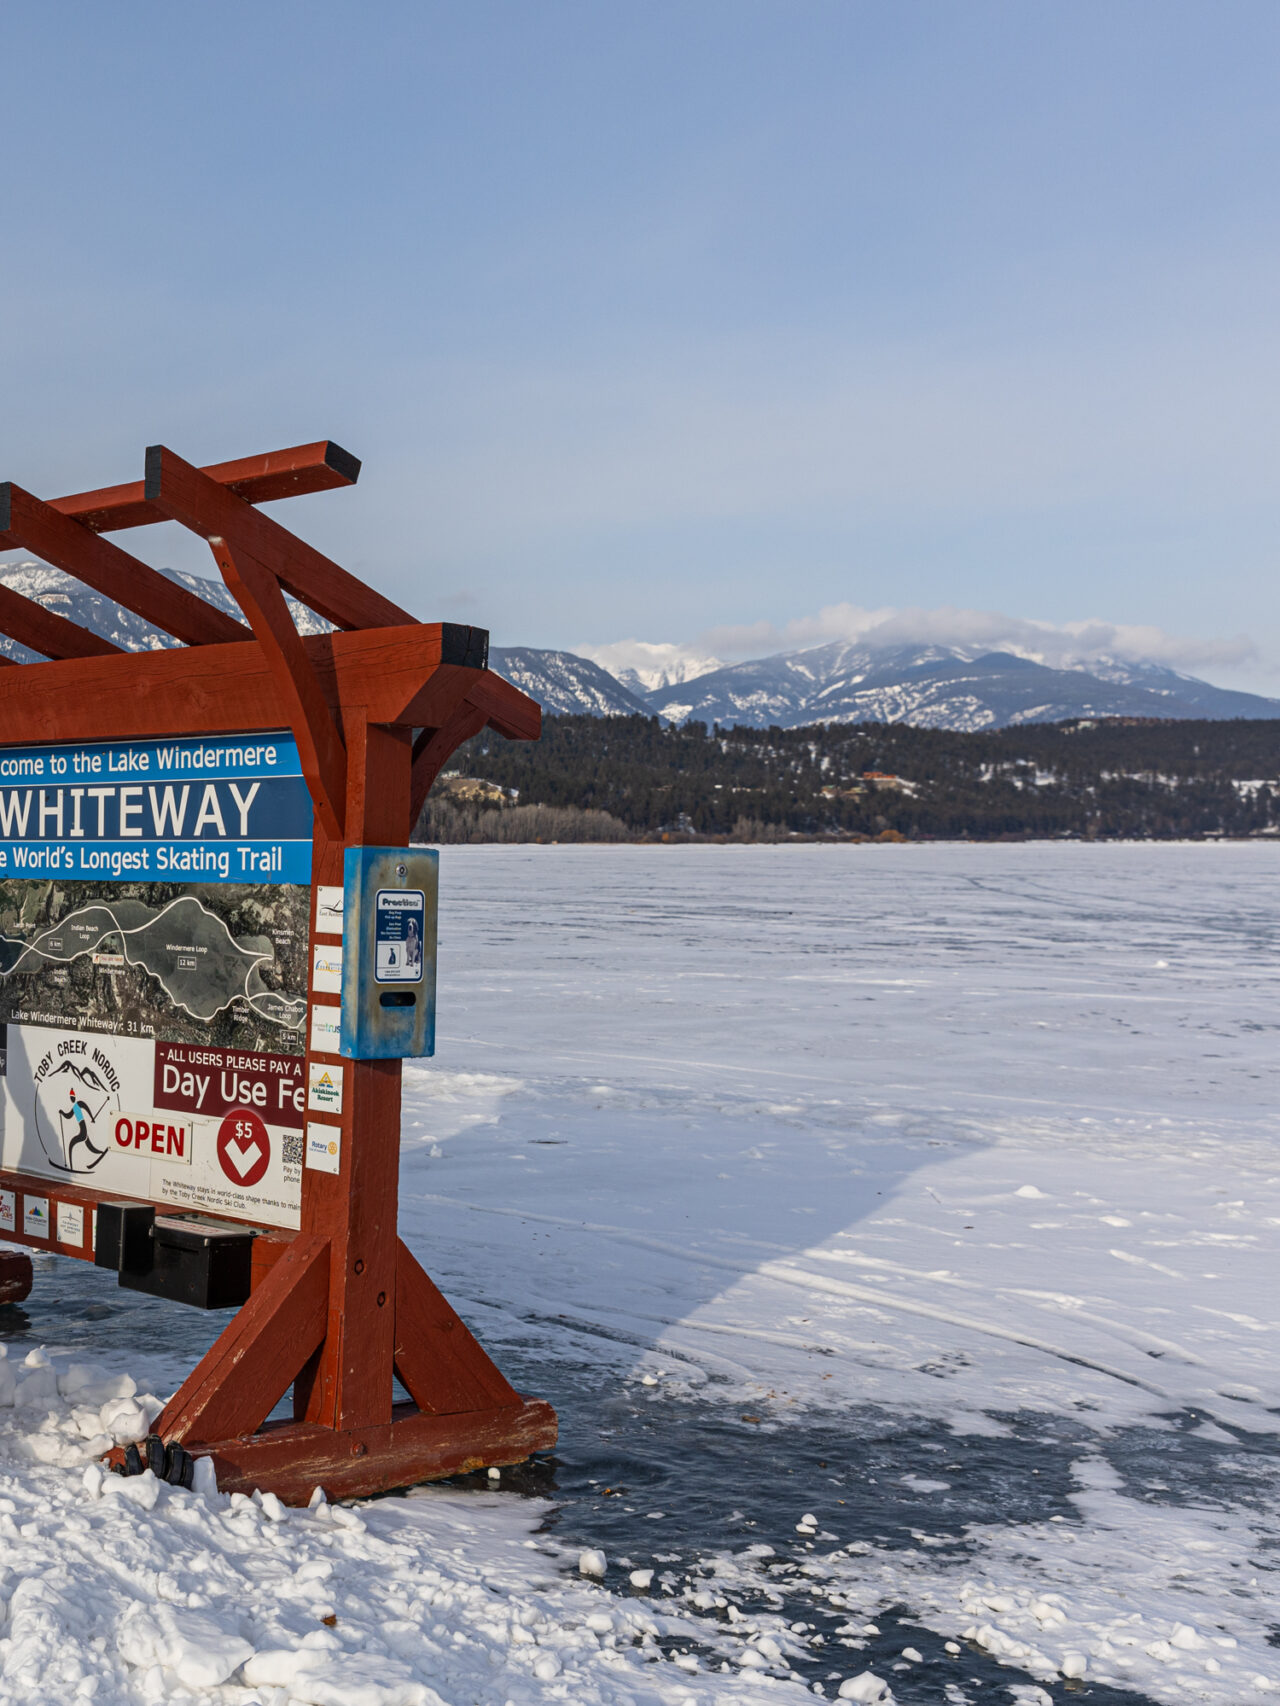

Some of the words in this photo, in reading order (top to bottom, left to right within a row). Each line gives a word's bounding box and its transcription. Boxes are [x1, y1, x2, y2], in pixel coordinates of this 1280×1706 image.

[49, 753, 67, 775] to
[72, 751, 102, 774] the
[108, 747, 150, 772] Lake
[156, 744, 277, 770] Windermere
[12, 845, 74, 868] World’s
[80, 846, 150, 876] Longest
[156, 846, 229, 878] Skating
[237, 846, 282, 871] Trail
[79, 932, 90, 940] Loop
[165, 944, 195, 952] Windermere
[195, 945, 208, 954] Loop
[11, 1009, 29, 1020] Lake
[30, 1011, 77, 1025] Windermere
[79, 1016, 118, 1031] Whiteway
[126, 1020, 138, 1032] 31
[140, 1021, 154, 1034] km
[278, 1011, 292, 1021] Loop
[287, 1033, 296, 1041] km
[33, 1051, 54, 1083] TOBY
[57, 1039, 88, 1057] CREEK
[91, 1047, 121, 1093] NORDIC
[167, 1049, 186, 1063] ALL
[188, 1050, 223, 1067] USERS
[226, 1055, 266, 1072] PLEASE
[270, 1060, 291, 1075] PAY
[293, 1063, 302, 1077] A
[163, 1064, 211, 1109] Day
[221, 1071, 267, 1107] Use
[278, 1078, 305, 1112] Fe
[114, 1117, 185, 1157] OPEN
[235, 1120, 253, 1140] $5
[311, 1141, 327, 1151] Rotary
[283, 1165, 292, 1175] Pay
[294, 1166, 301, 1176] by
[283, 1175, 300, 1184] phone
[162, 1178, 172, 1187] The
[173, 1180, 196, 1192] Whiteway
[197, 1185, 210, 1195] stays
[217, 1189, 245, 1201] world-class
[245, 1194, 261, 1205] shape
[262, 1197, 280, 1208] thanks
[280, 1200, 287, 1209] to
[162, 1187, 168, 1195] by
[169, 1187, 178, 1196] the
[179, 1189, 190, 1200] Toby
[191, 1192, 206, 1201] Creek
[207, 1195, 223, 1206] Nordic
[224, 1198, 232, 1206] Ski
